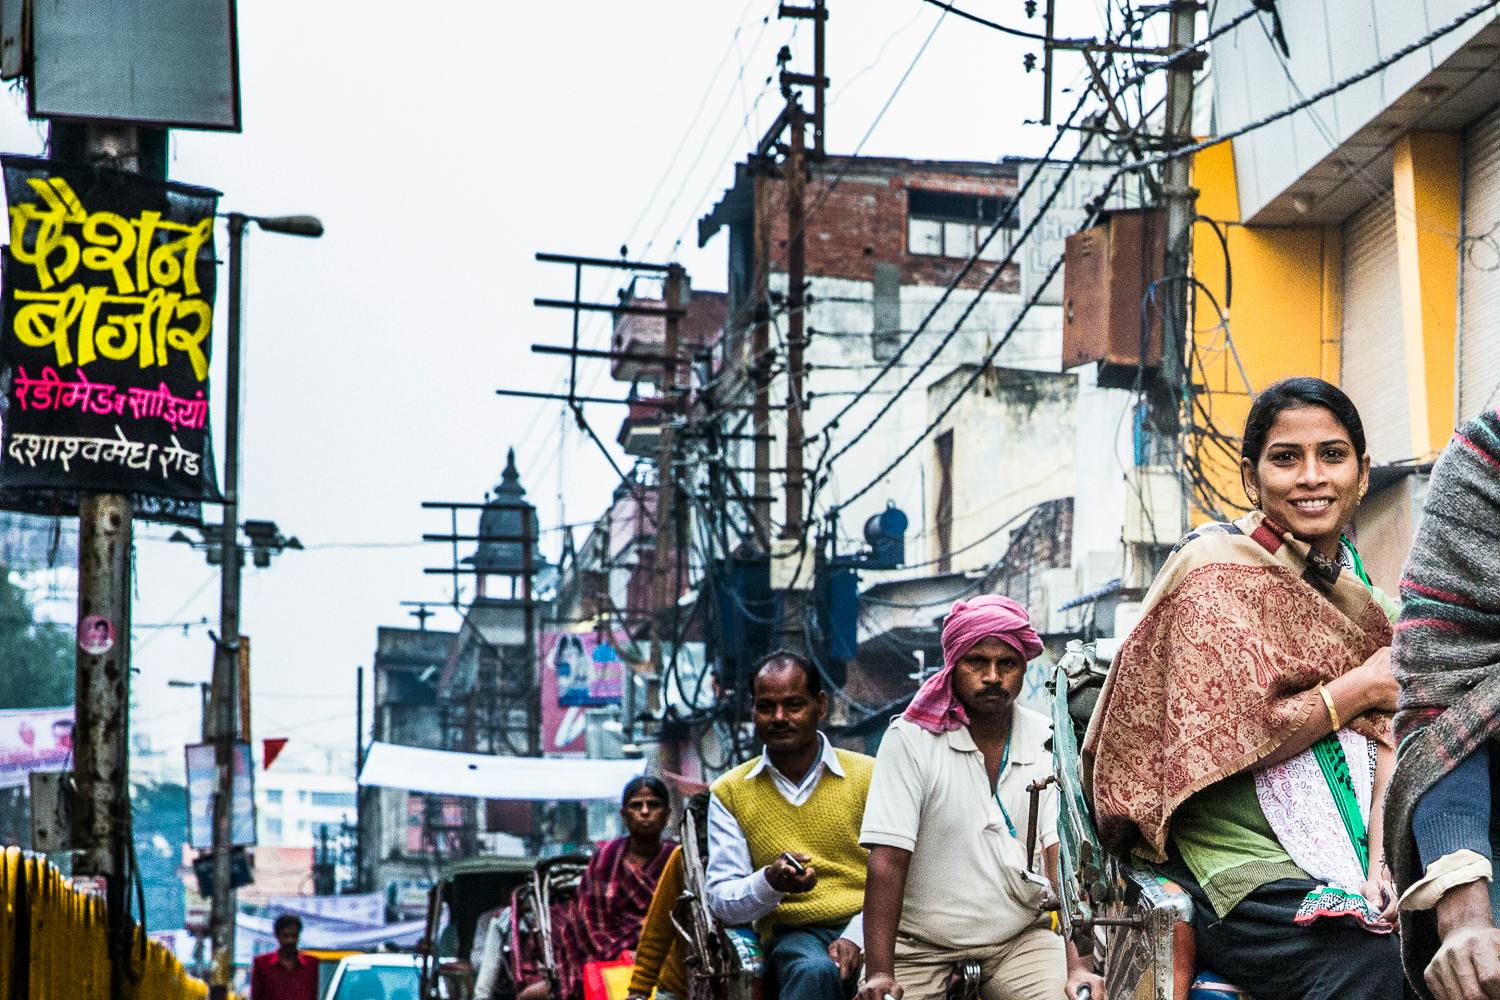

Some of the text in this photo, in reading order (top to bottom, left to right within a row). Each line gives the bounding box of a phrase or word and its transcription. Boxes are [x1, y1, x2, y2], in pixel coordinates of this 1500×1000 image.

[10, 178, 214, 295] फैशन
[14, 365, 116, 414] रेडीमेड
[159, 434, 200, 479] रोड
